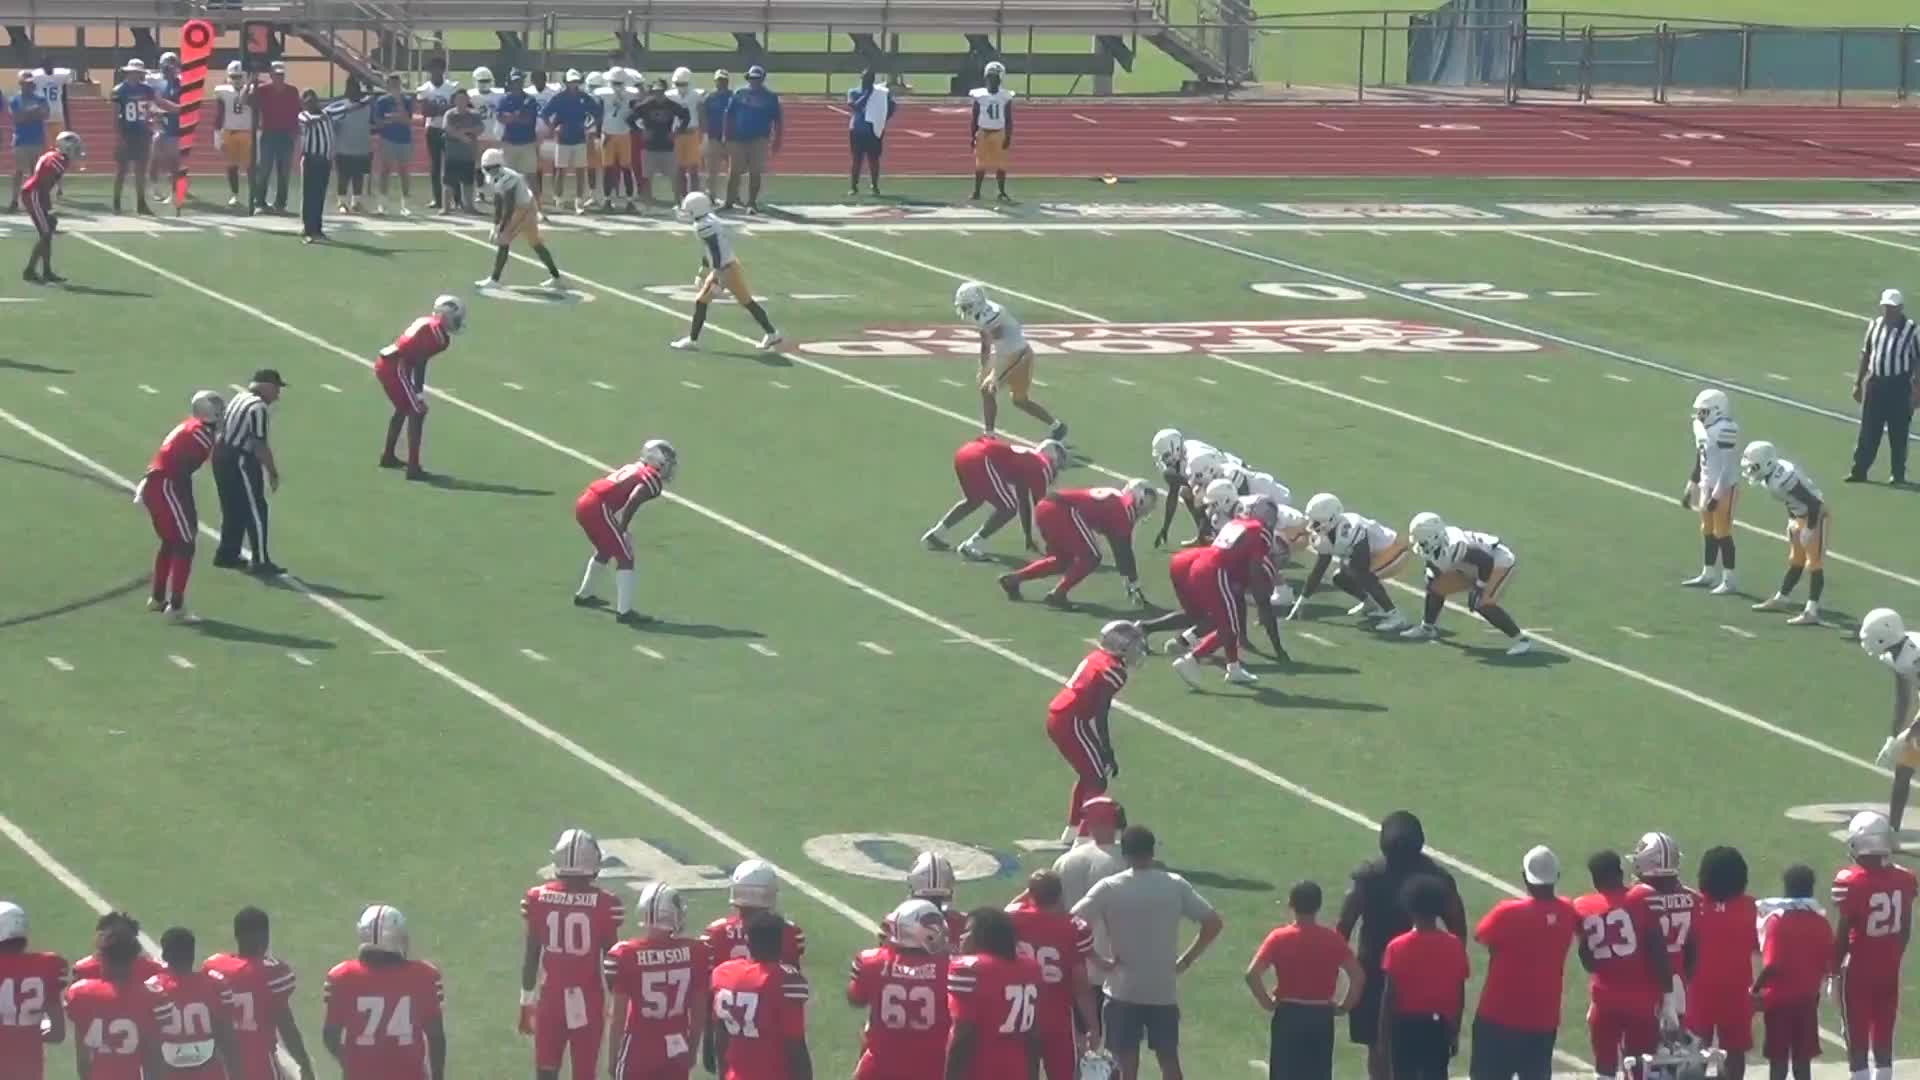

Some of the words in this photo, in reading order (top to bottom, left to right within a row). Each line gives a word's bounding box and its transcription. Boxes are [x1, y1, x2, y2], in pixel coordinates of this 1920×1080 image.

[546, 911, 591, 955] 10
[1583, 908, 1637, 959] 23
[1866, 890, 1902, 937] 21
[641, 968, 690, 1018] 57
[881, 984, 935, 1029] 63
[999, 984, 1037, 1032] 76
[356, 996, 412, 1045] 74
